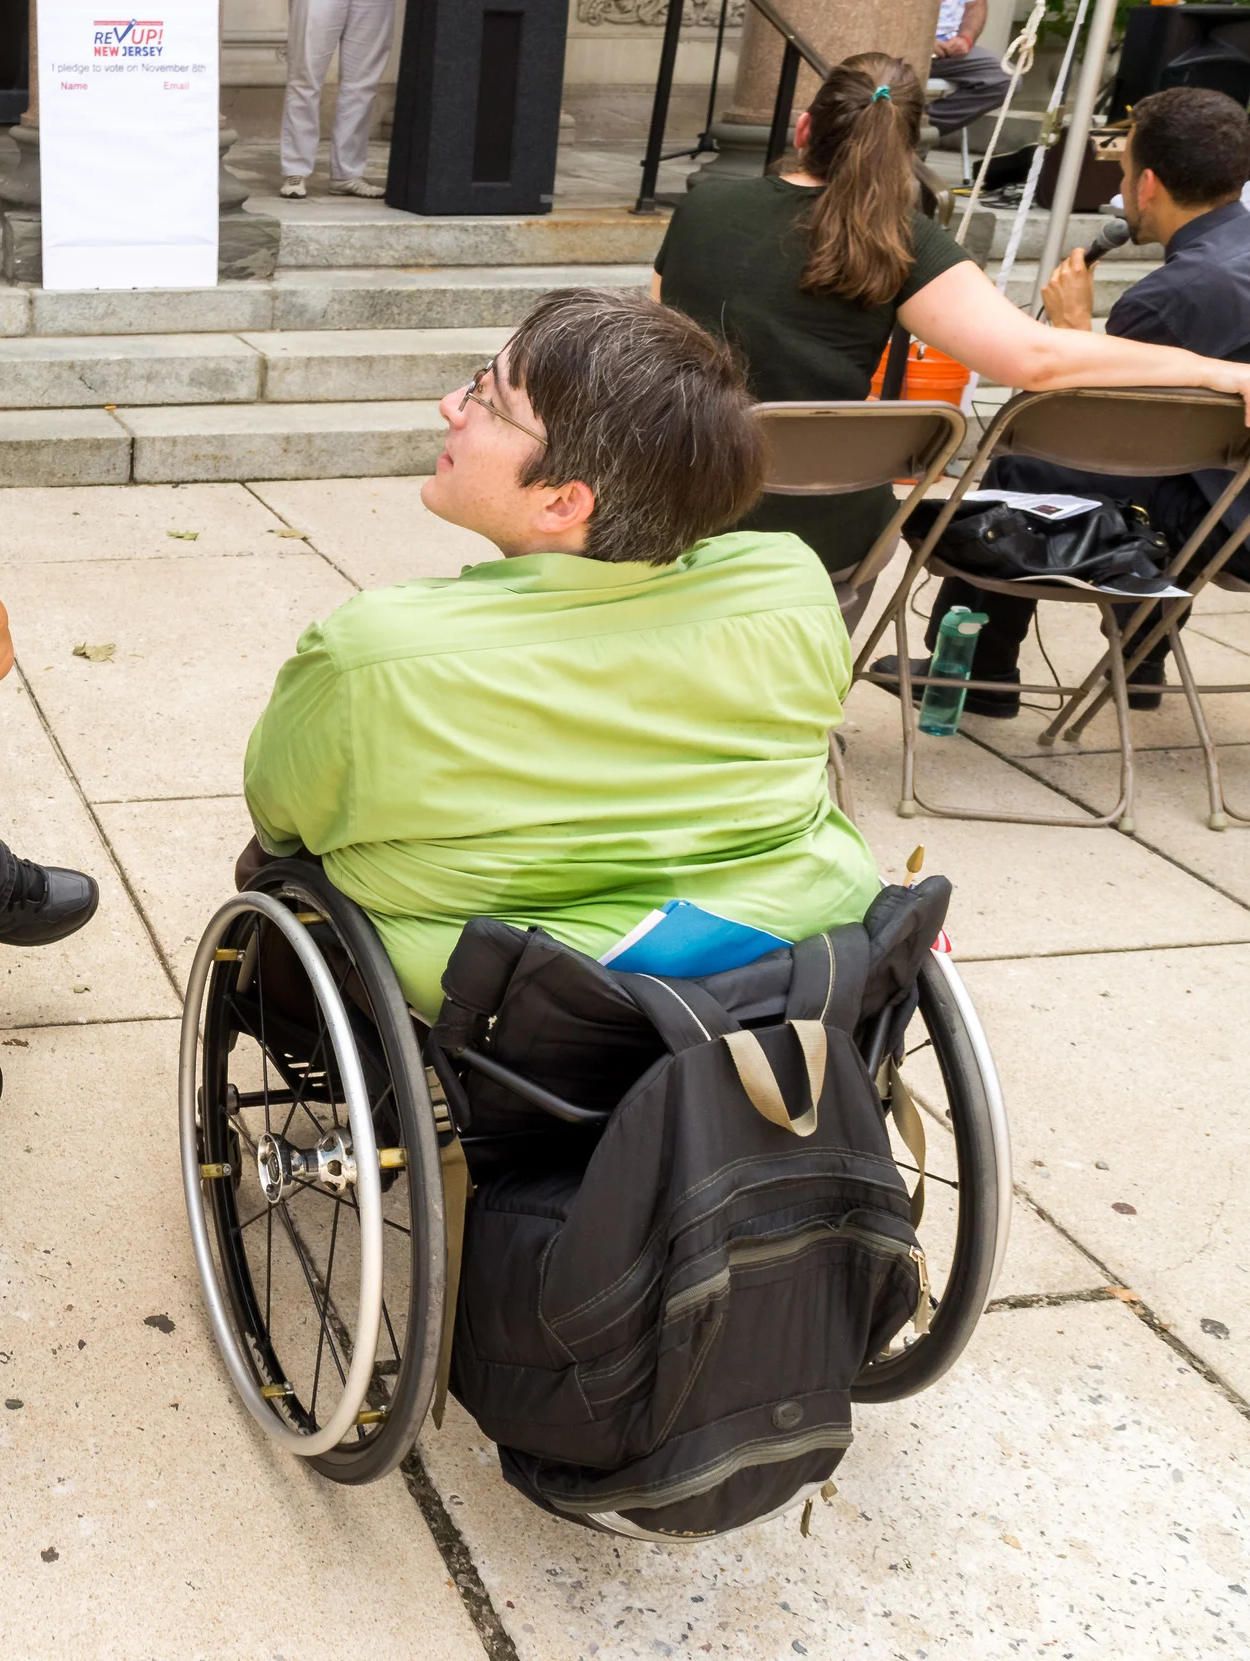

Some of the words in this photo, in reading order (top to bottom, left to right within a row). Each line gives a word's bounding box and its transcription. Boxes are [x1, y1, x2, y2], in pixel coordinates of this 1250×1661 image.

[94, 47, 119, 56] NEW
[122, 47, 163, 57] JERSEY
[58, 63, 90, 74] pledge
[92, 64, 102, 72] to
[104, 64, 124, 72] vote
[142, 64, 189, 73] November
[192, 64, 206, 73] 8th
[61, 82, 88, 90] Name
[164, 82, 190, 90] Email
